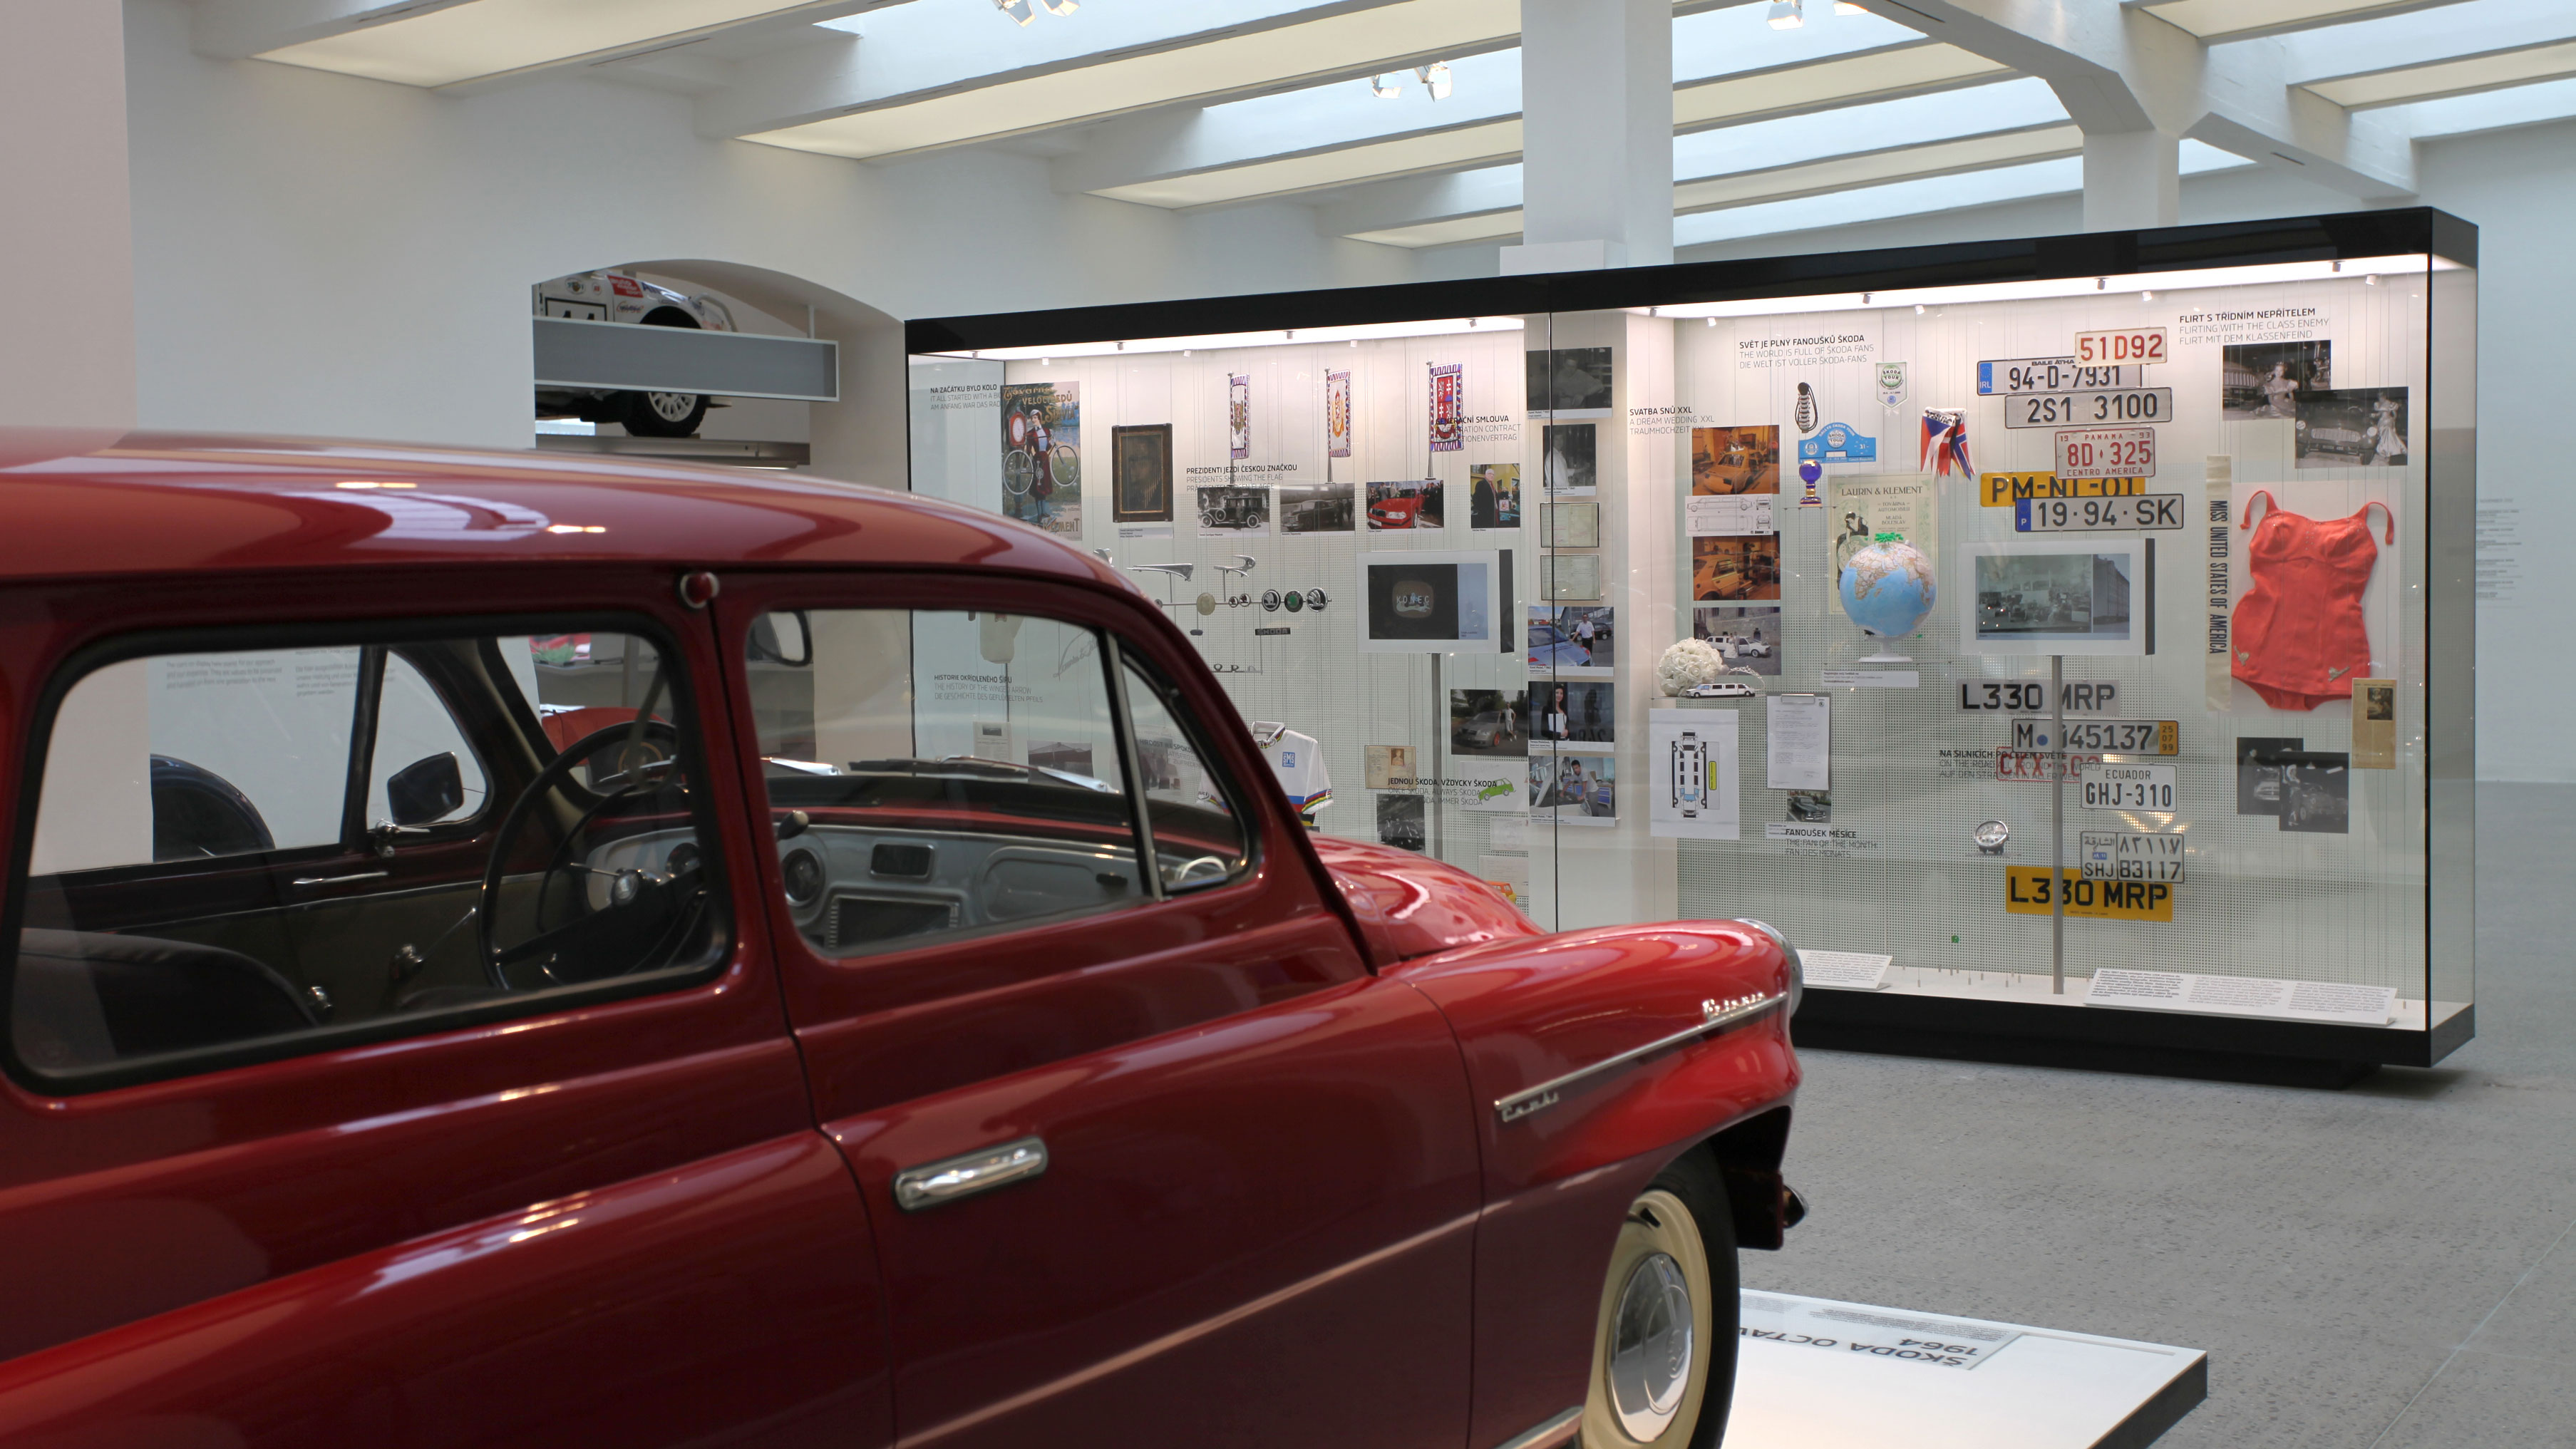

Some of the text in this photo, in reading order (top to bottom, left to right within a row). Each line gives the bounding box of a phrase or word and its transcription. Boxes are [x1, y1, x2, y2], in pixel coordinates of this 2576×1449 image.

[2215, 311, 2253, 321] TŘÍDNÍM
[2257, 308, 2315, 319] NEPŘÍTELEM
[2180, 325, 2217, 334] FLIRTING
[2267, 320, 2294, 329] CLASS
[2298, 319, 2329, 327] ENEMY
[1740, 340, 1758, 349] SVĚT
[1793, 335, 1835, 345] FANOUŠKŮ
[2247, 331, 2312, 341] KLASSENFEIND
[1756, 349, 1783, 358] WORLD
[1827, 345, 1852, 354] ŠKODA
[1819, 355, 1867, 364] ŠKODA-FANS
[2009, 365, 2119, 391] 94-D-7931
[1660, 406, 1675, 414] SNŮ
[2027, 393, 2157, 423] 2S1 3100
[1631, 426, 1690, 435] TRAUMHOCHZEIT
[2110, 440, 2151, 465] 325
[1842, 488, 1872, 496] LAURIN
[2210, 500, 2227, 654] MISS UNITED STATES OF AMERICA
[1396, 596, 1429, 604] KONEC
[1962, 684, 2043, 710] L330
[2017, 723, 2034, 748] M
[1954, 748, 1993, 757] SILNICÍCH
[2106, 770, 2150, 780] ECUADOR
[1442, 778, 1471, 787] VŽDYCKY
[1461, 797, 1483, 805] ŠKODA
[2086, 783, 2171, 807] GHJ-310
[1786, 828, 1826, 837] FANOUŠEK
[1829, 829, 1856, 838] MĚSÍCE
[1819, 850, 1851, 858] MONATS
[2084, 860, 2181, 880] SHJ 83117
[2104, 882, 2168, 909] MRP
[1851, 1341, 1968, 1367] ŠKODA
[1899, 1339, 1977, 1356] 1964
